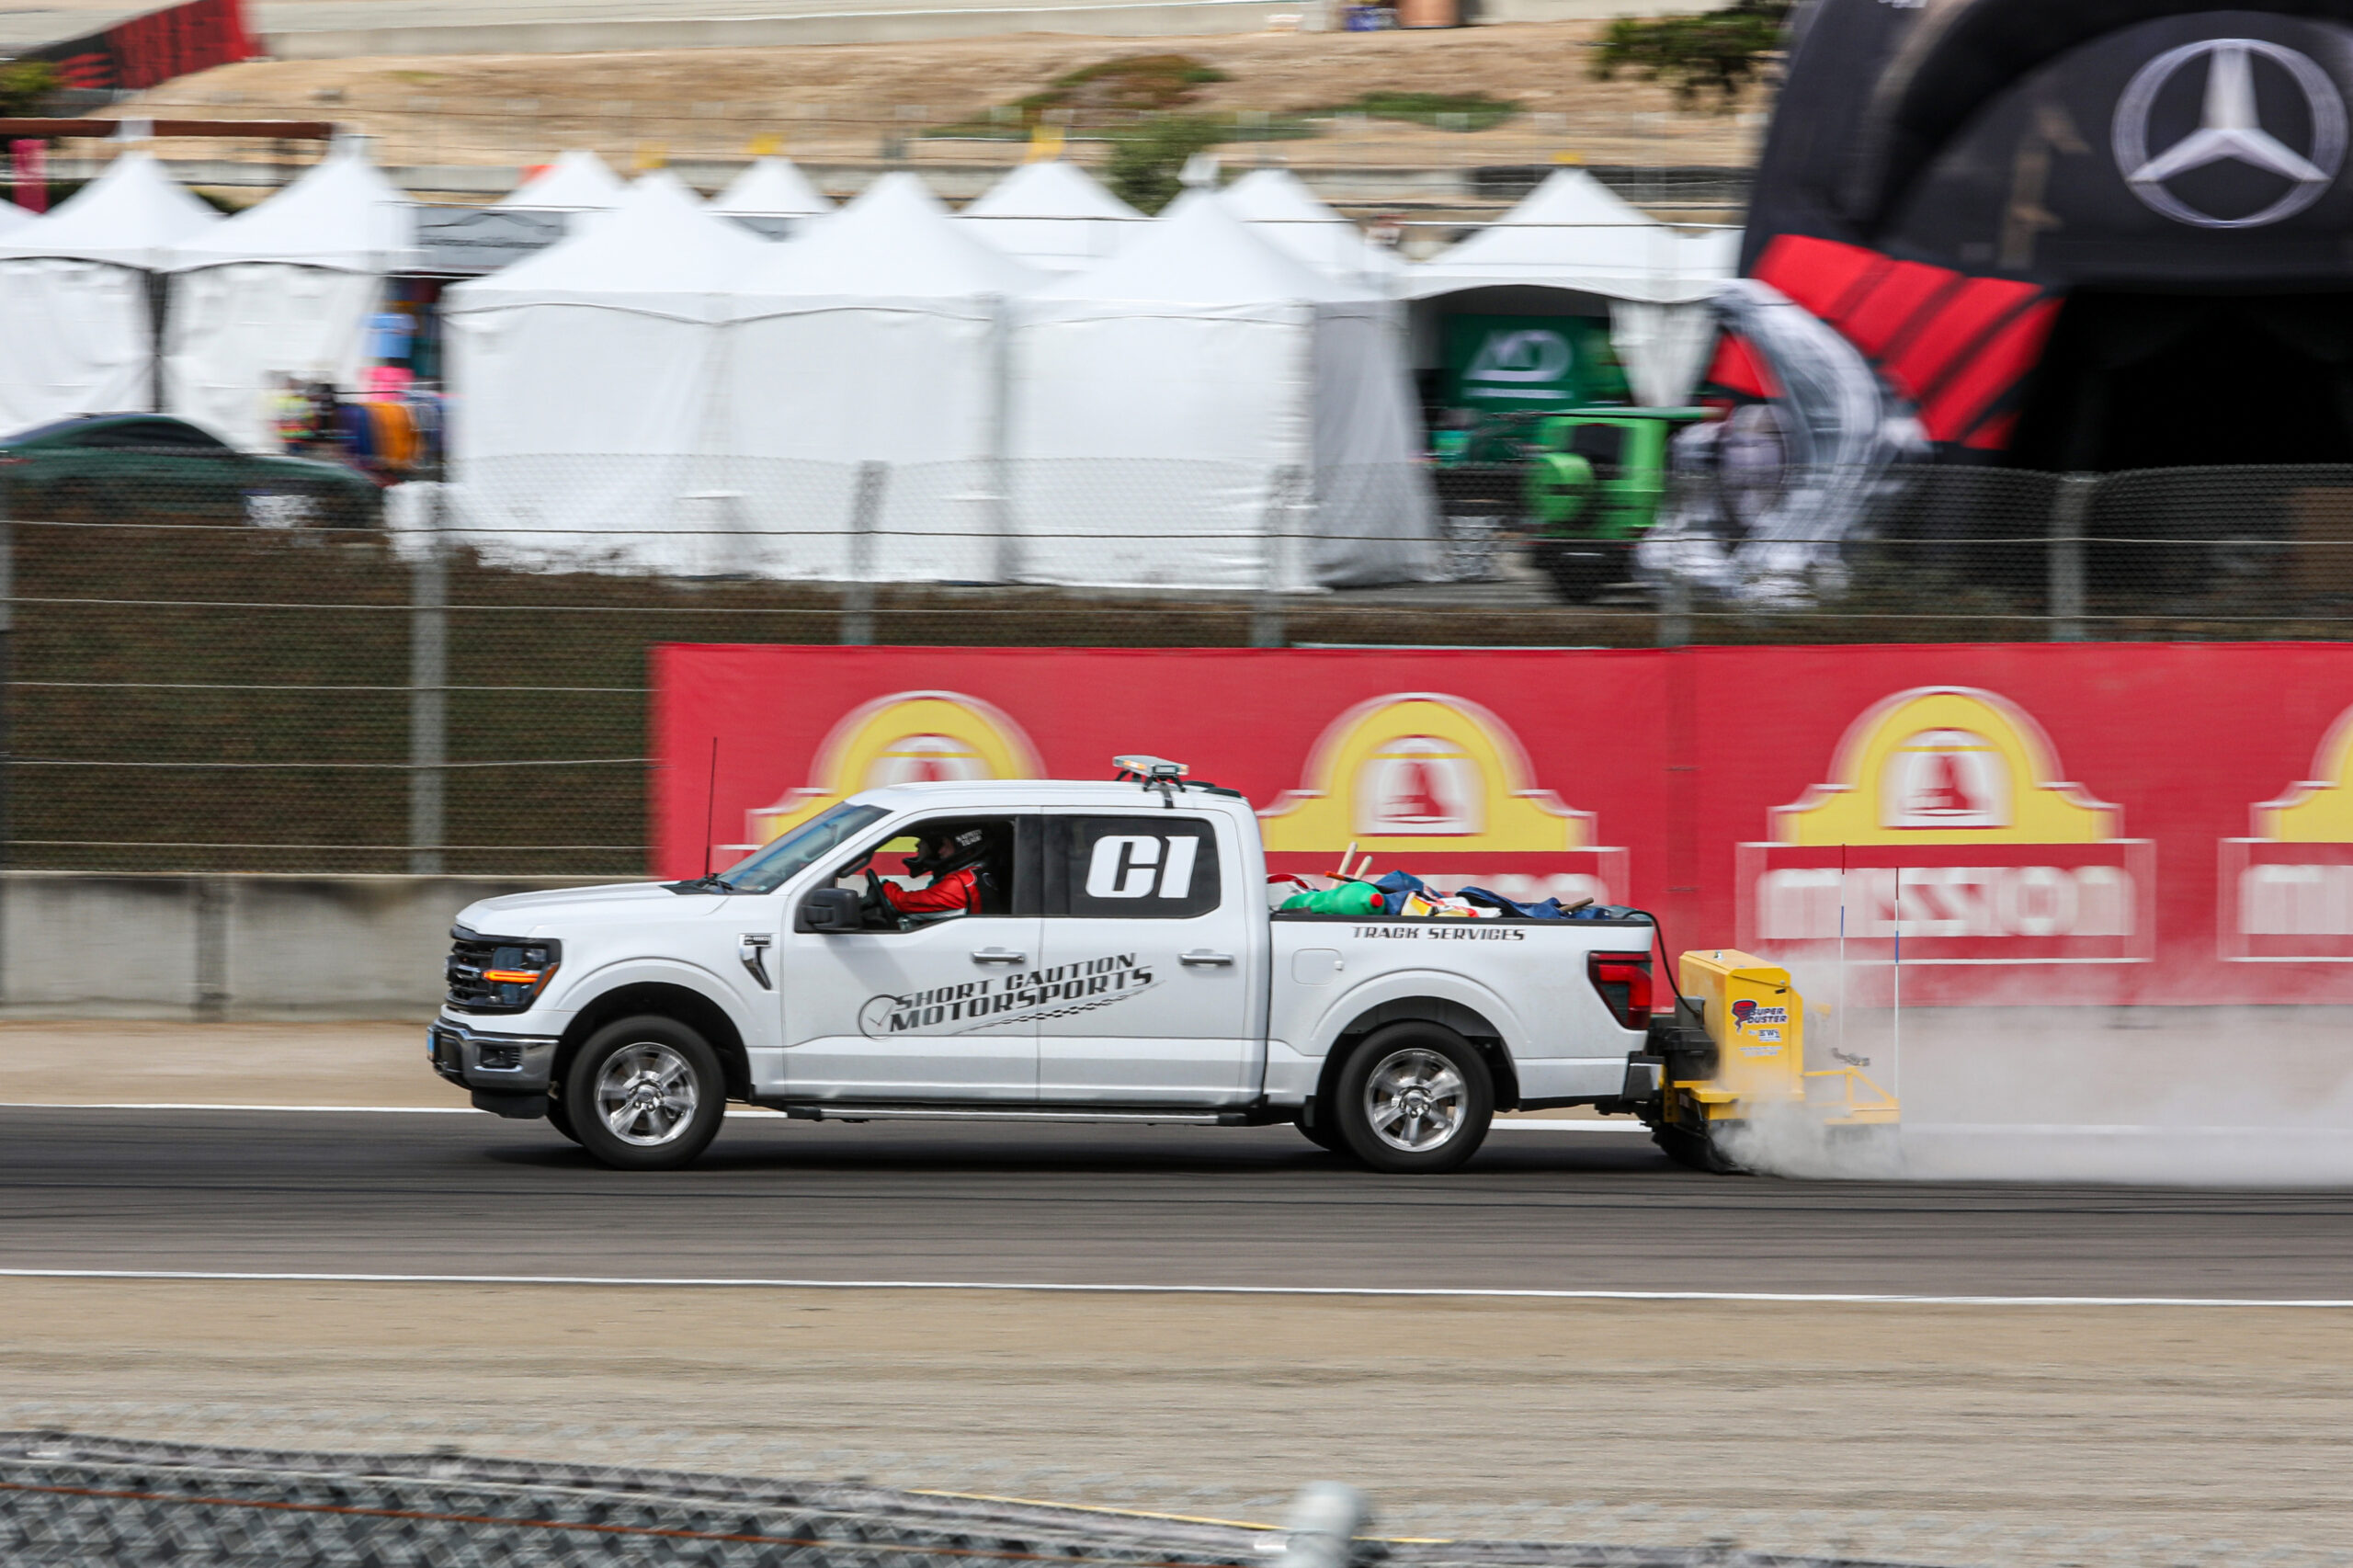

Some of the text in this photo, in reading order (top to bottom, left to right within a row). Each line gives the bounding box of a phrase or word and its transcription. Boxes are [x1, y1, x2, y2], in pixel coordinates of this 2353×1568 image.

[1352, 926, 1526, 941] TRACK SERVICES
[889, 965, 1154, 1032] MOTORSPORTS
[894, 952, 1138, 1011] SHORT CAUTION
